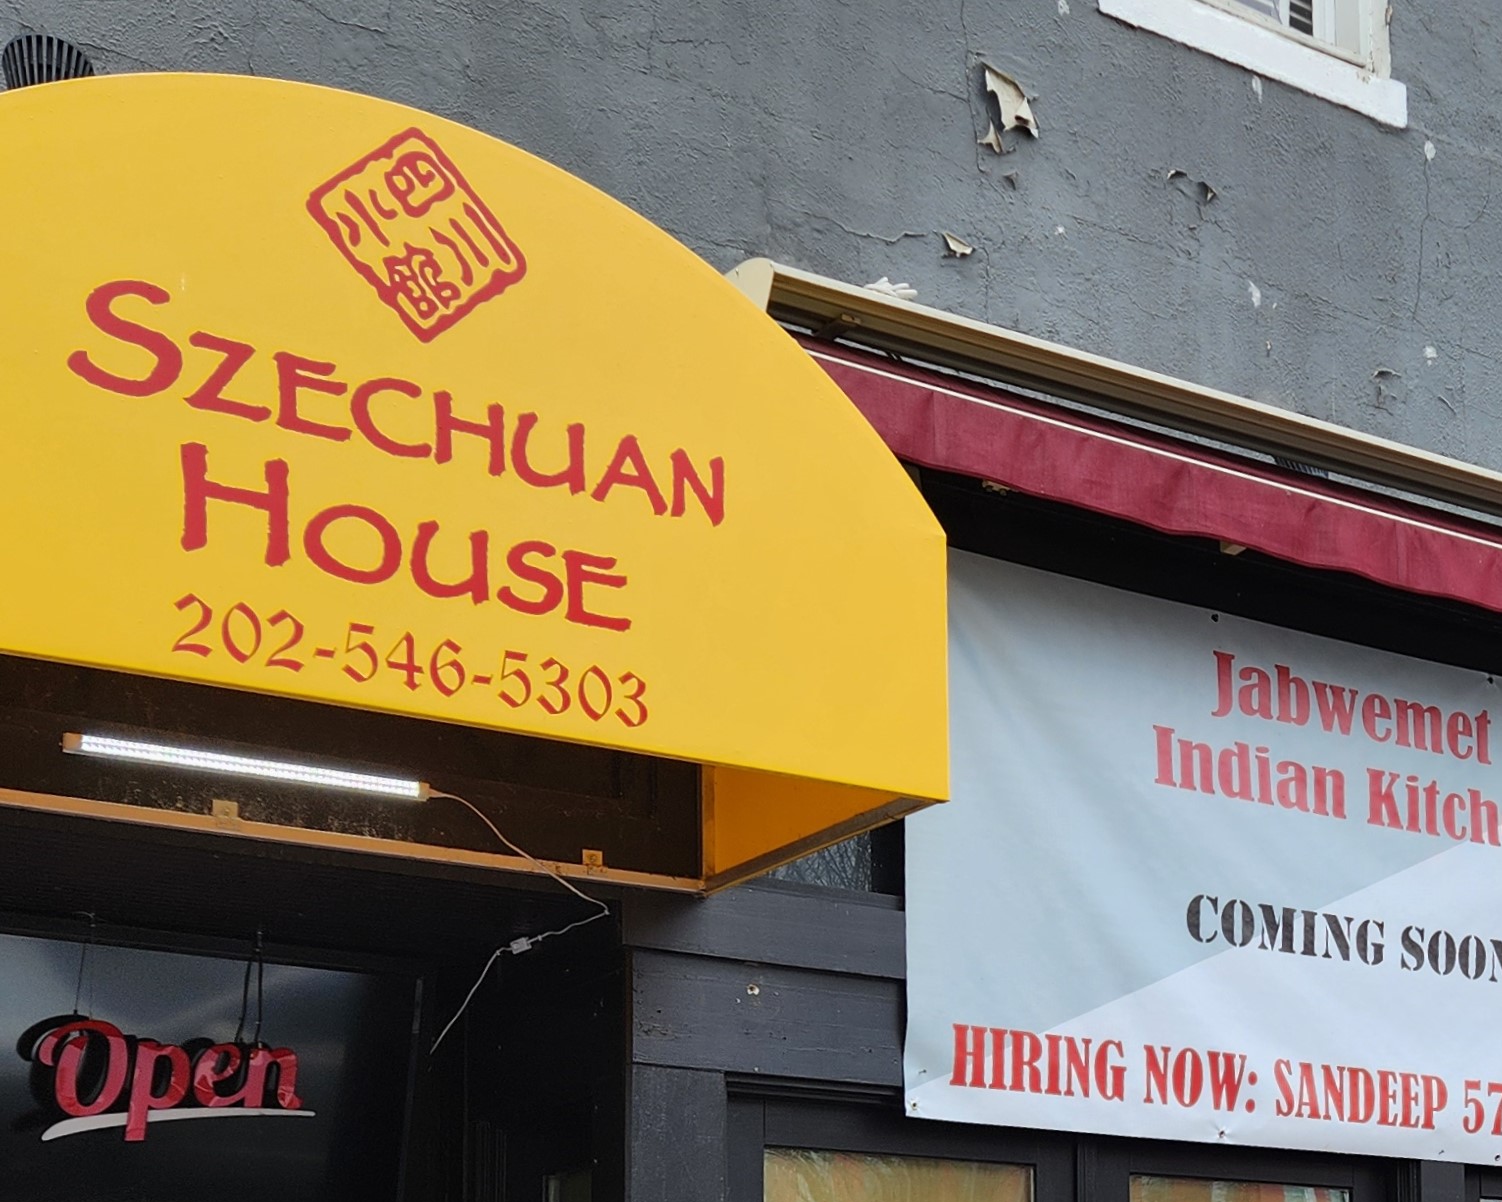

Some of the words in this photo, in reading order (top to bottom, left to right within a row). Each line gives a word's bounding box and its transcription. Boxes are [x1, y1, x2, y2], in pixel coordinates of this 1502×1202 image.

[171, 592, 650, 729] 202-546-5303
[1210, 650, 1493, 766] Jabwemet
[1152, 725, 1347, 820] Indian
[1186, 893, 1386, 967] COMING
[38, 1018, 305, 1142] Open
[949, 1023, 1126, 1104] HIRING
[1142, 1044, 1258, 1114] NOW:
[1273, 1058, 1448, 1130] SANDEEP
